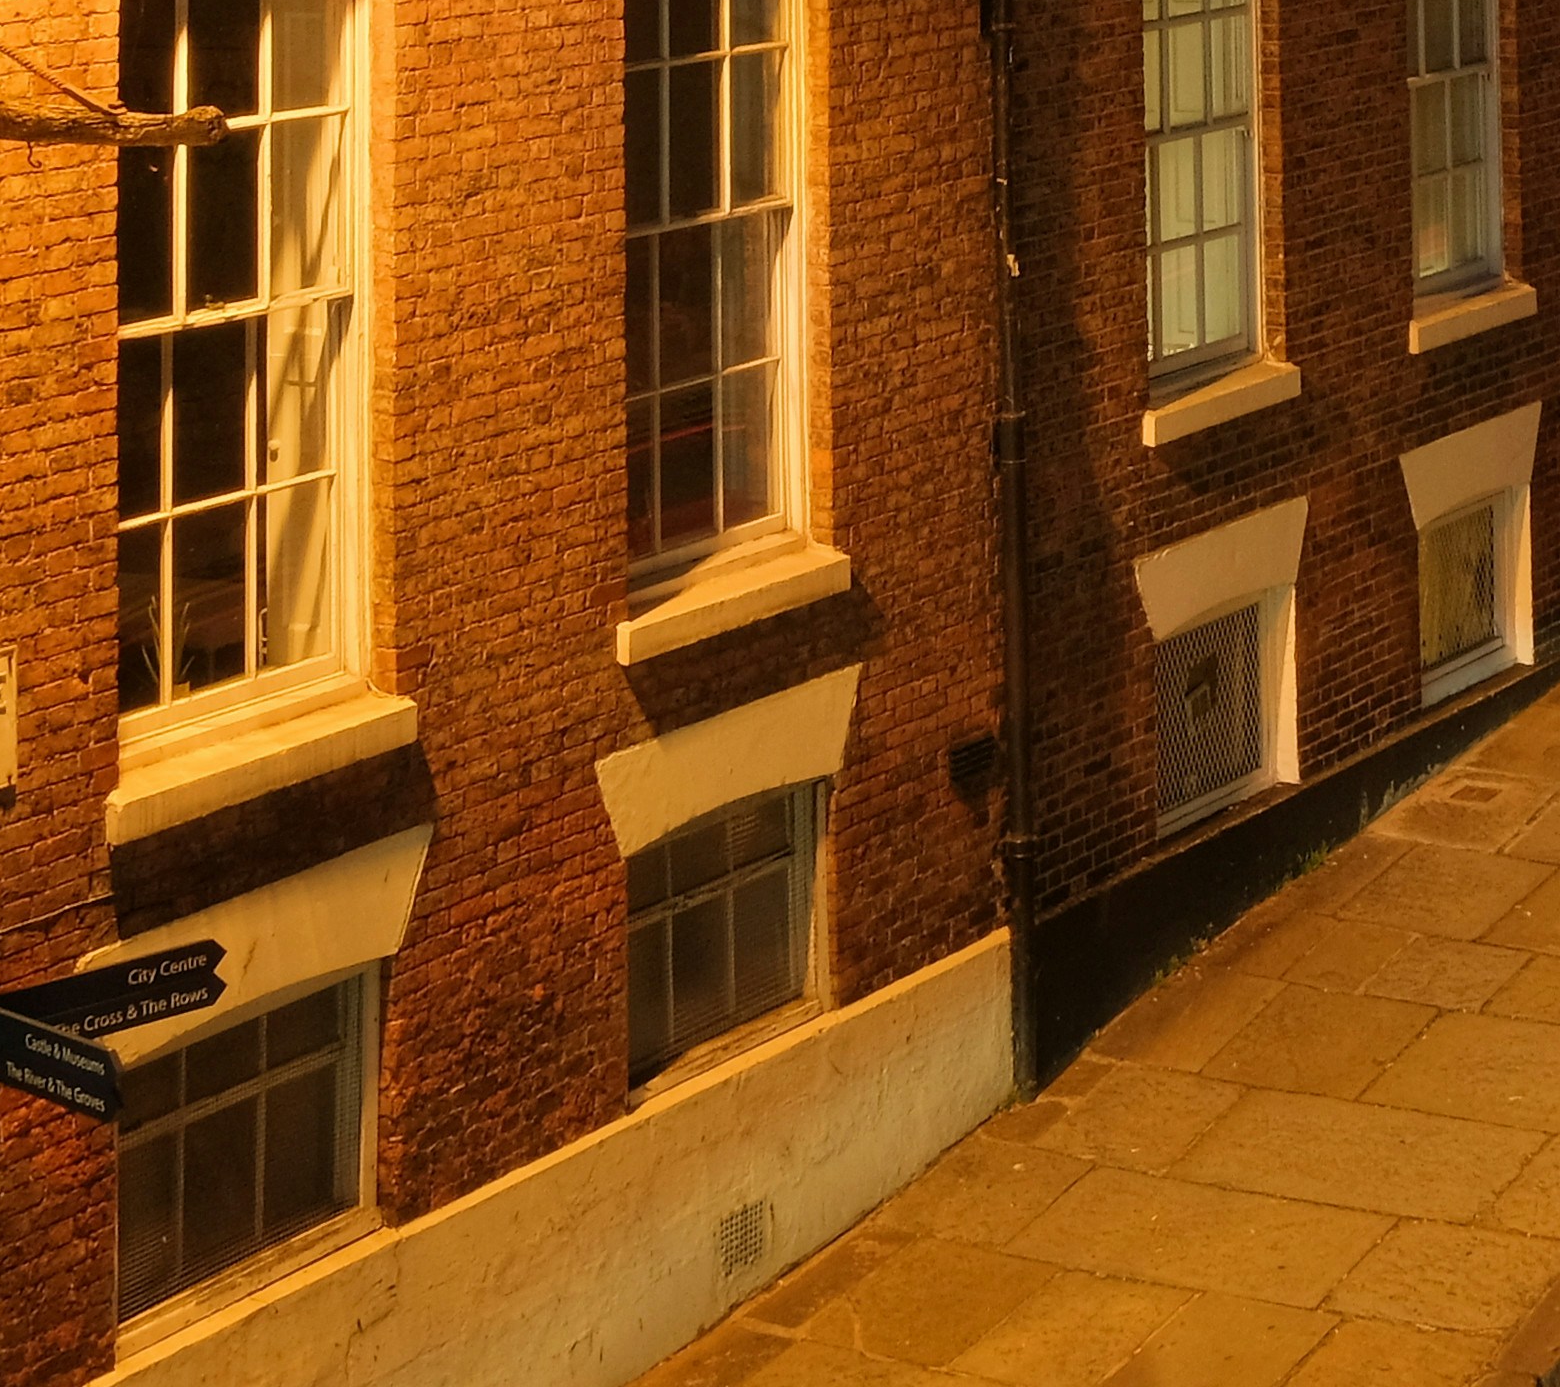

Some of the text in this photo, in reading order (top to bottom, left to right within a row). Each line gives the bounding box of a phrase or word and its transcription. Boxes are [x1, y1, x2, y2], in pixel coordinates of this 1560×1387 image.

[127, 954, 208, 986] City Centre
[83, 1010, 124, 1032] Cross
[125, 1004, 138, 1020] &
[140, 999, 168, 1017] The
[171, 987, 209, 1009] Rows
[25, 1033, 105, 1076] Castle & Museums
[6, 1060, 106, 1113] The River & The Groves
